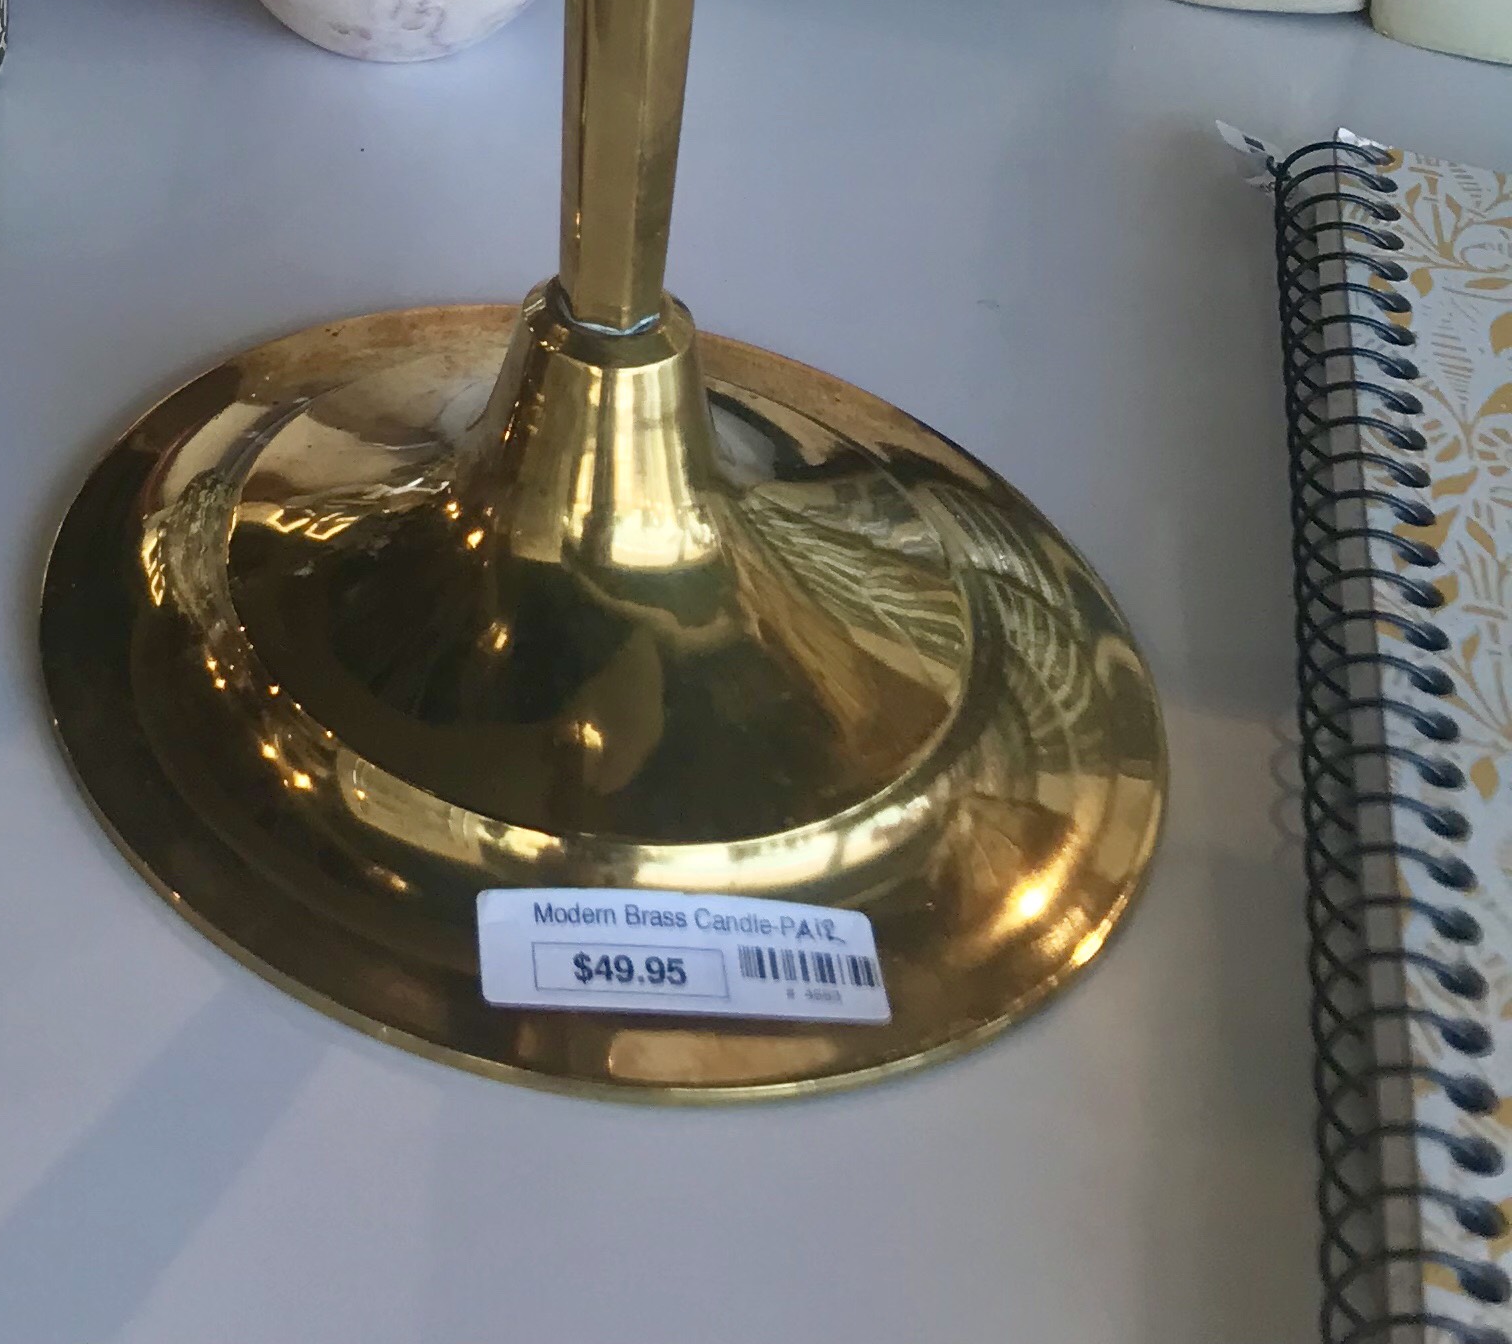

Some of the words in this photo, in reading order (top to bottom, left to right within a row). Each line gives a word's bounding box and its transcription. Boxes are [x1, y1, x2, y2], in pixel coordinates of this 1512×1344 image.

[533, 901, 616, 925] Modern
[624, 903, 688, 928] Brass
[572, 950, 687, 986] $49.95
